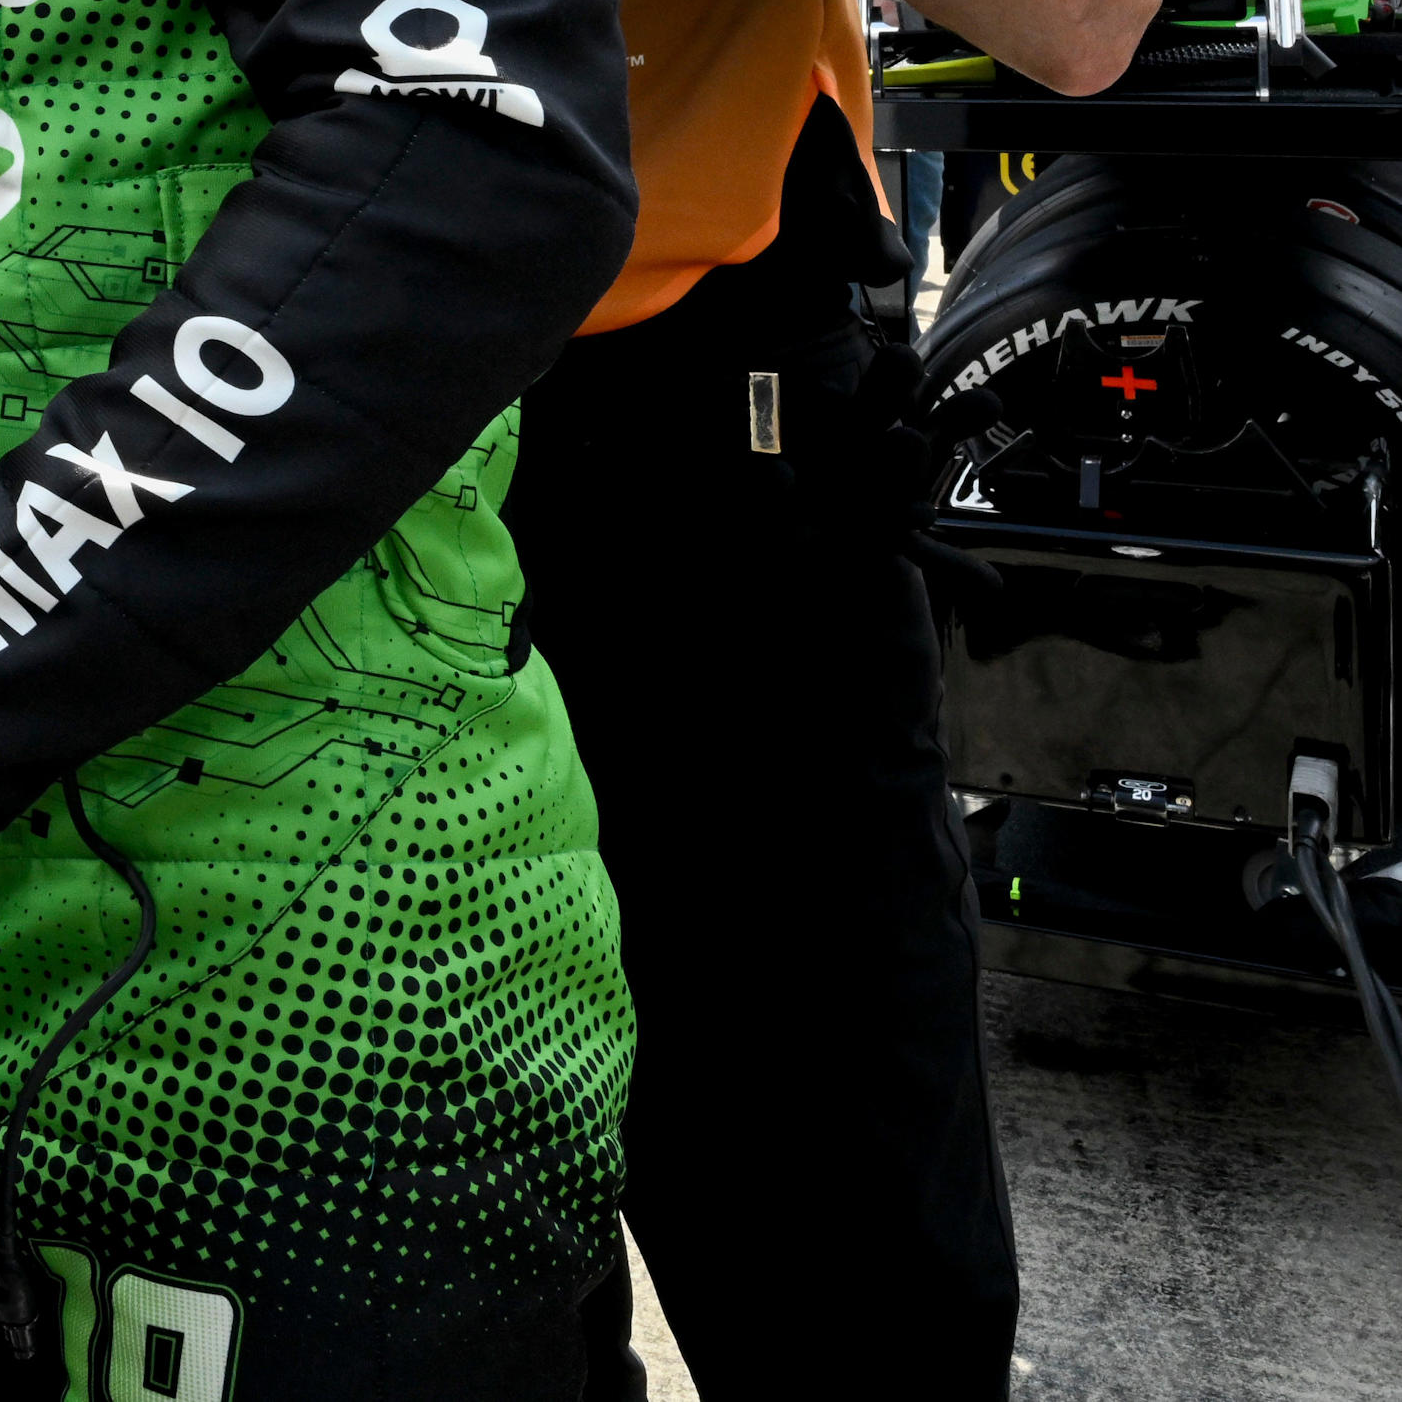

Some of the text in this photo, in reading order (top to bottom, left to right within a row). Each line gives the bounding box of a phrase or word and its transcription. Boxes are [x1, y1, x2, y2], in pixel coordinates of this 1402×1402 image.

[929, 298, 1203, 413] REHAWK
[1281, 327, 1381, 383] INDY
[1132, 788, 1152, 801] 20
